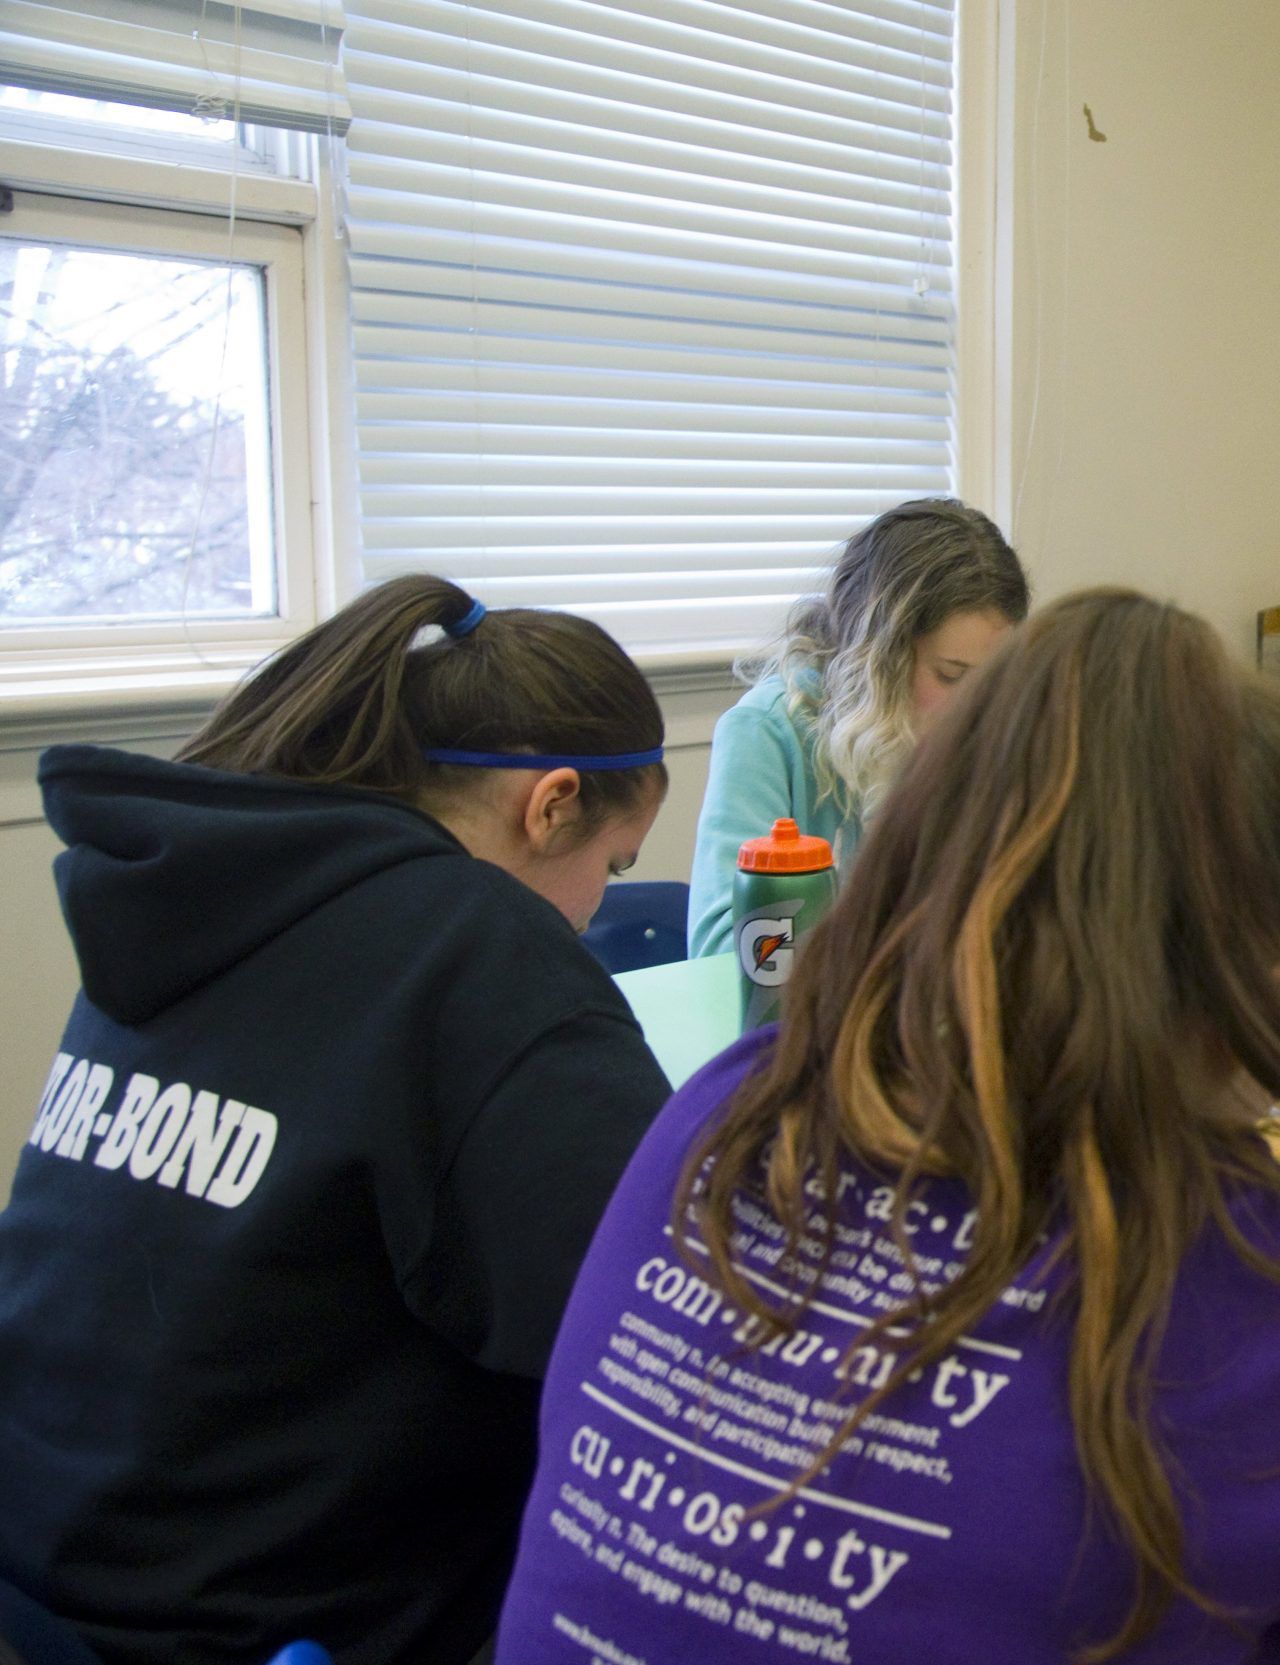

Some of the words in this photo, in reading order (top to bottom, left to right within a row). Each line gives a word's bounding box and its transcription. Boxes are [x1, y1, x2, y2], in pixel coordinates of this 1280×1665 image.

[609, 1333, 638, 1360] with
[635, 1349, 671, 1379] open
[668, 1367, 789, 1432] communication
[787, 1416, 835, 1448] built
[864, 1442, 953, 1484] respect,
[619, 1311, 691, 1362] community
[729, 1367, 811, 1416] accepting
[811, 1399, 941, 1448] envionment
[682, 1406, 719, 1431] and
[712, 1419, 830, 1477] participatio.
[550, 1508, 594, 1558] explore,
[595, 1543, 625, 1573] and
[622, 1560, 683, 1604] engage
[684, 1589, 732, 1625] with
[734, 1606, 776, 1641] the
[777, 1625, 852, 1664] world.
[560, 1482, 611, 1531] curiosity
[625, 1521, 658, 1557] The
[656, 1541, 716, 1584] desire
[717, 1567, 743, 1595] to
[744, 1580, 848, 1634] question,
